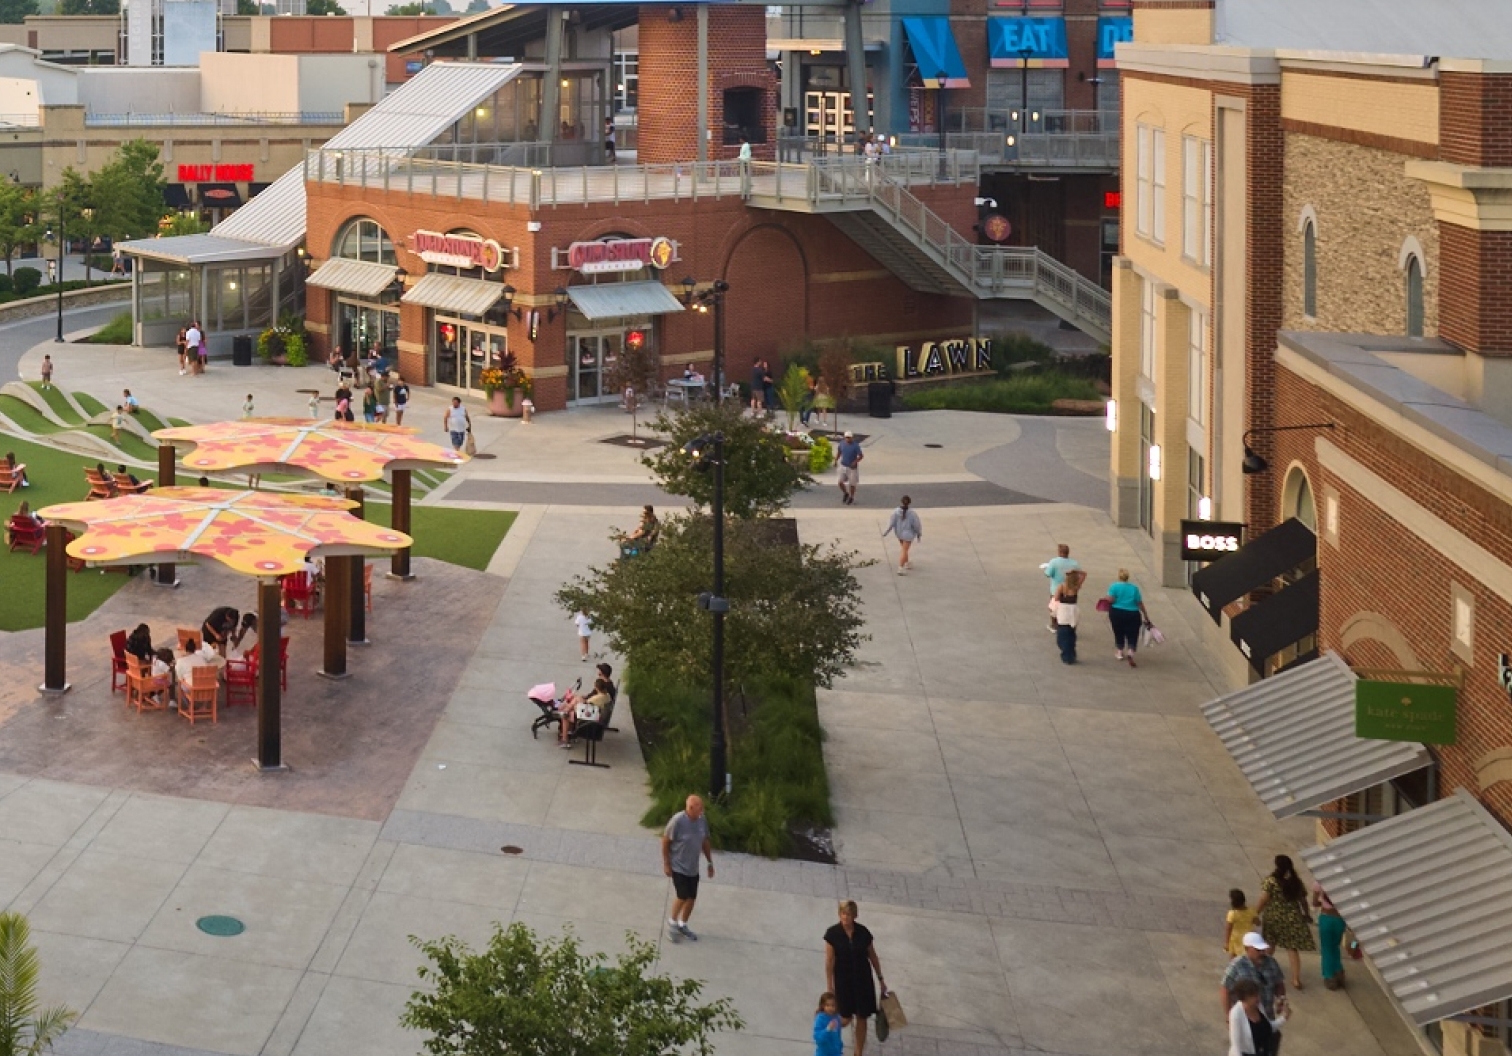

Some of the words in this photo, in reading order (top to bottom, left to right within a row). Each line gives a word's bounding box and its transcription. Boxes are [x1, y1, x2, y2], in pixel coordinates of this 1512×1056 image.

[1003, 24, 1050, 51] EAT
[178, 163, 214, 182] RALLY
[215, 163, 255, 182] HOUSE
[897, 338, 993, 379] LAWN
[1187, 534, 1238, 551] BOSS
